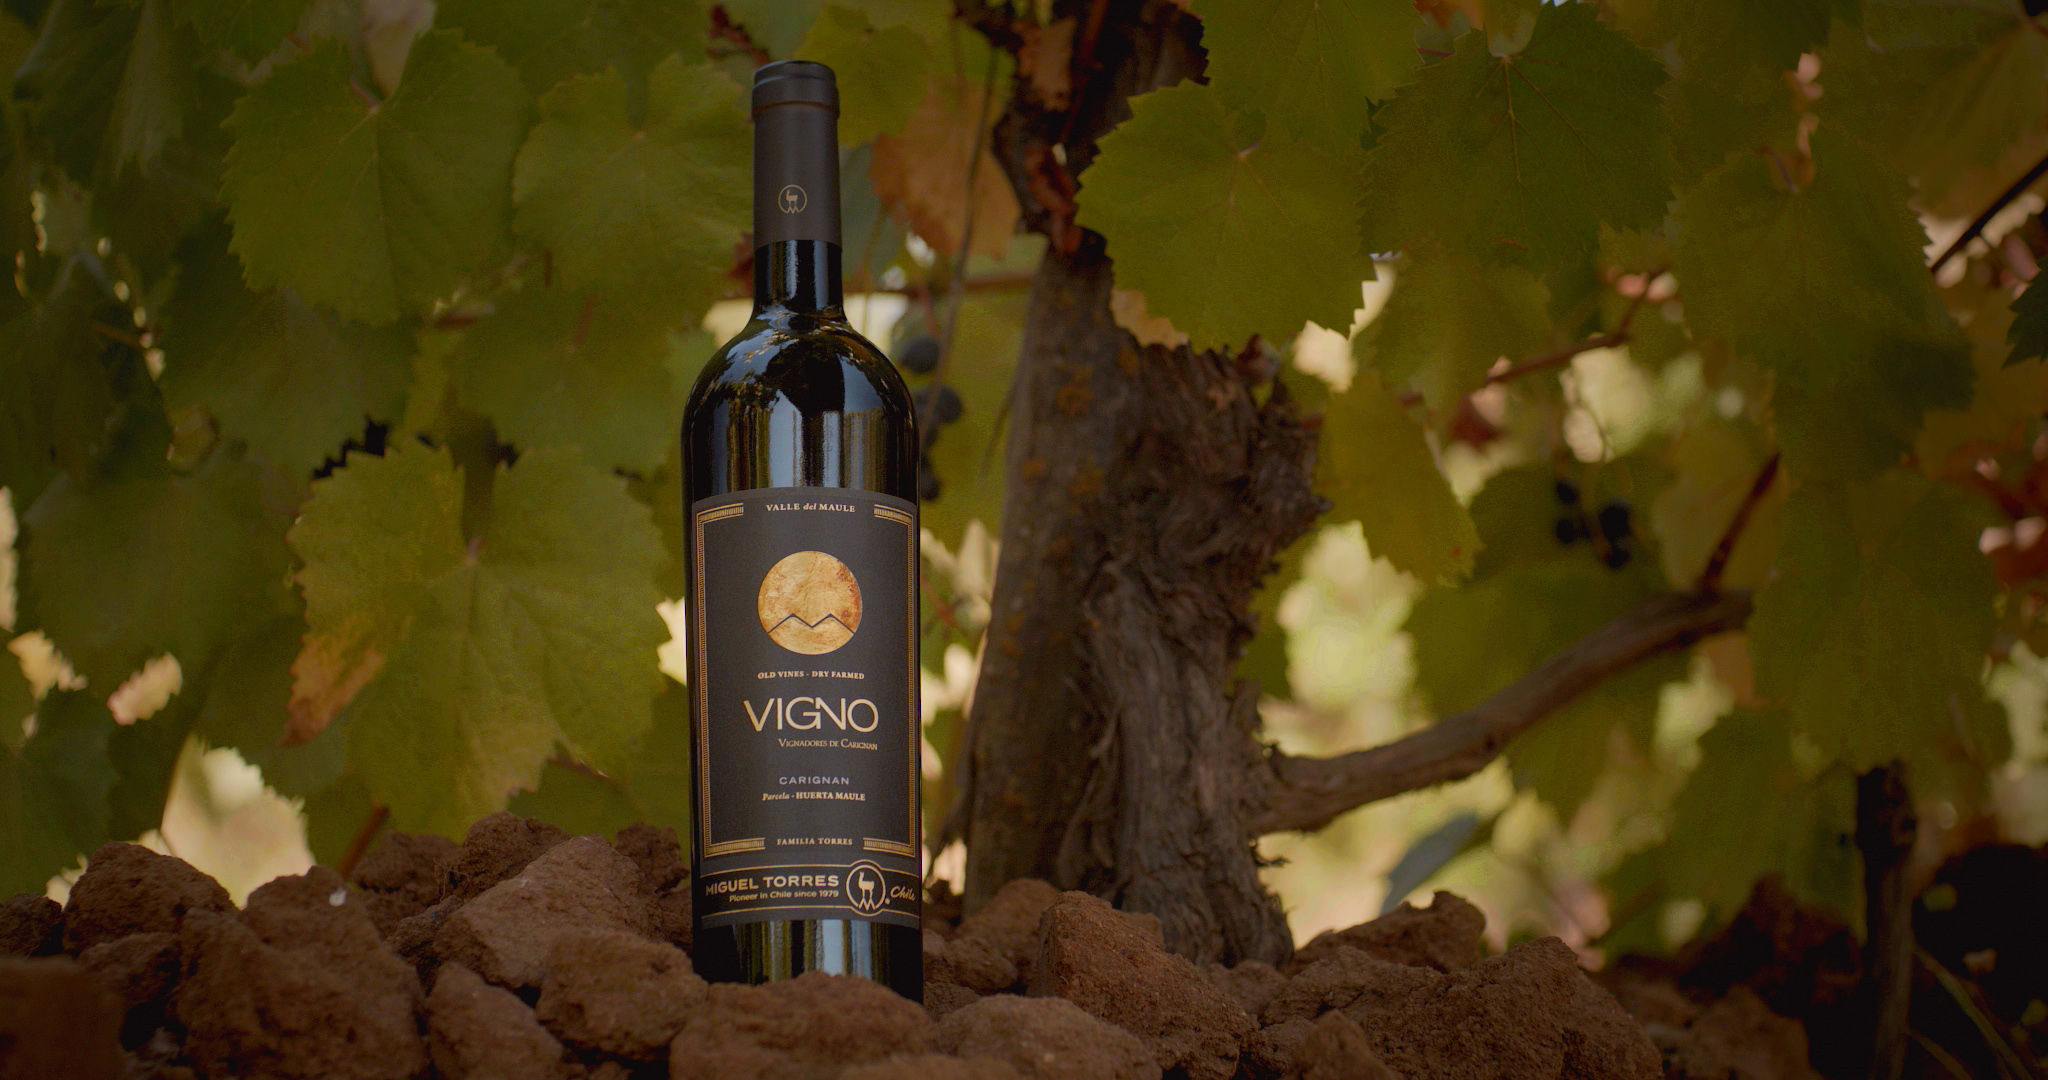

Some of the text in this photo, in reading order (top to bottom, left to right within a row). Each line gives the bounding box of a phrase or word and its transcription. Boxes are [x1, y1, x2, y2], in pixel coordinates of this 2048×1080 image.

[766, 502, 855, 513] VALLE del MAULE
[757, 671, 776, 680] OLD
[778, 670, 804, 679] VINES
[812, 670, 830, 678] DRY
[831, 670, 865, 680] FARMED
[743, 697, 879, 733] VIGNO
[779, 776, 850, 785] CARIGNAN
[762, 792, 790, 801] Parcela
[796, 792, 834, 800] HUERTA
[835, 792, 866, 801] MAULE
[777, 838, 853, 846] FAMILIA TORRES
[706, 875, 839, 896] MIGUEL TORRES
[729, 889, 839, 903] Pioneer in Chile since 1979
[890, 885, 915, 901] Chile
